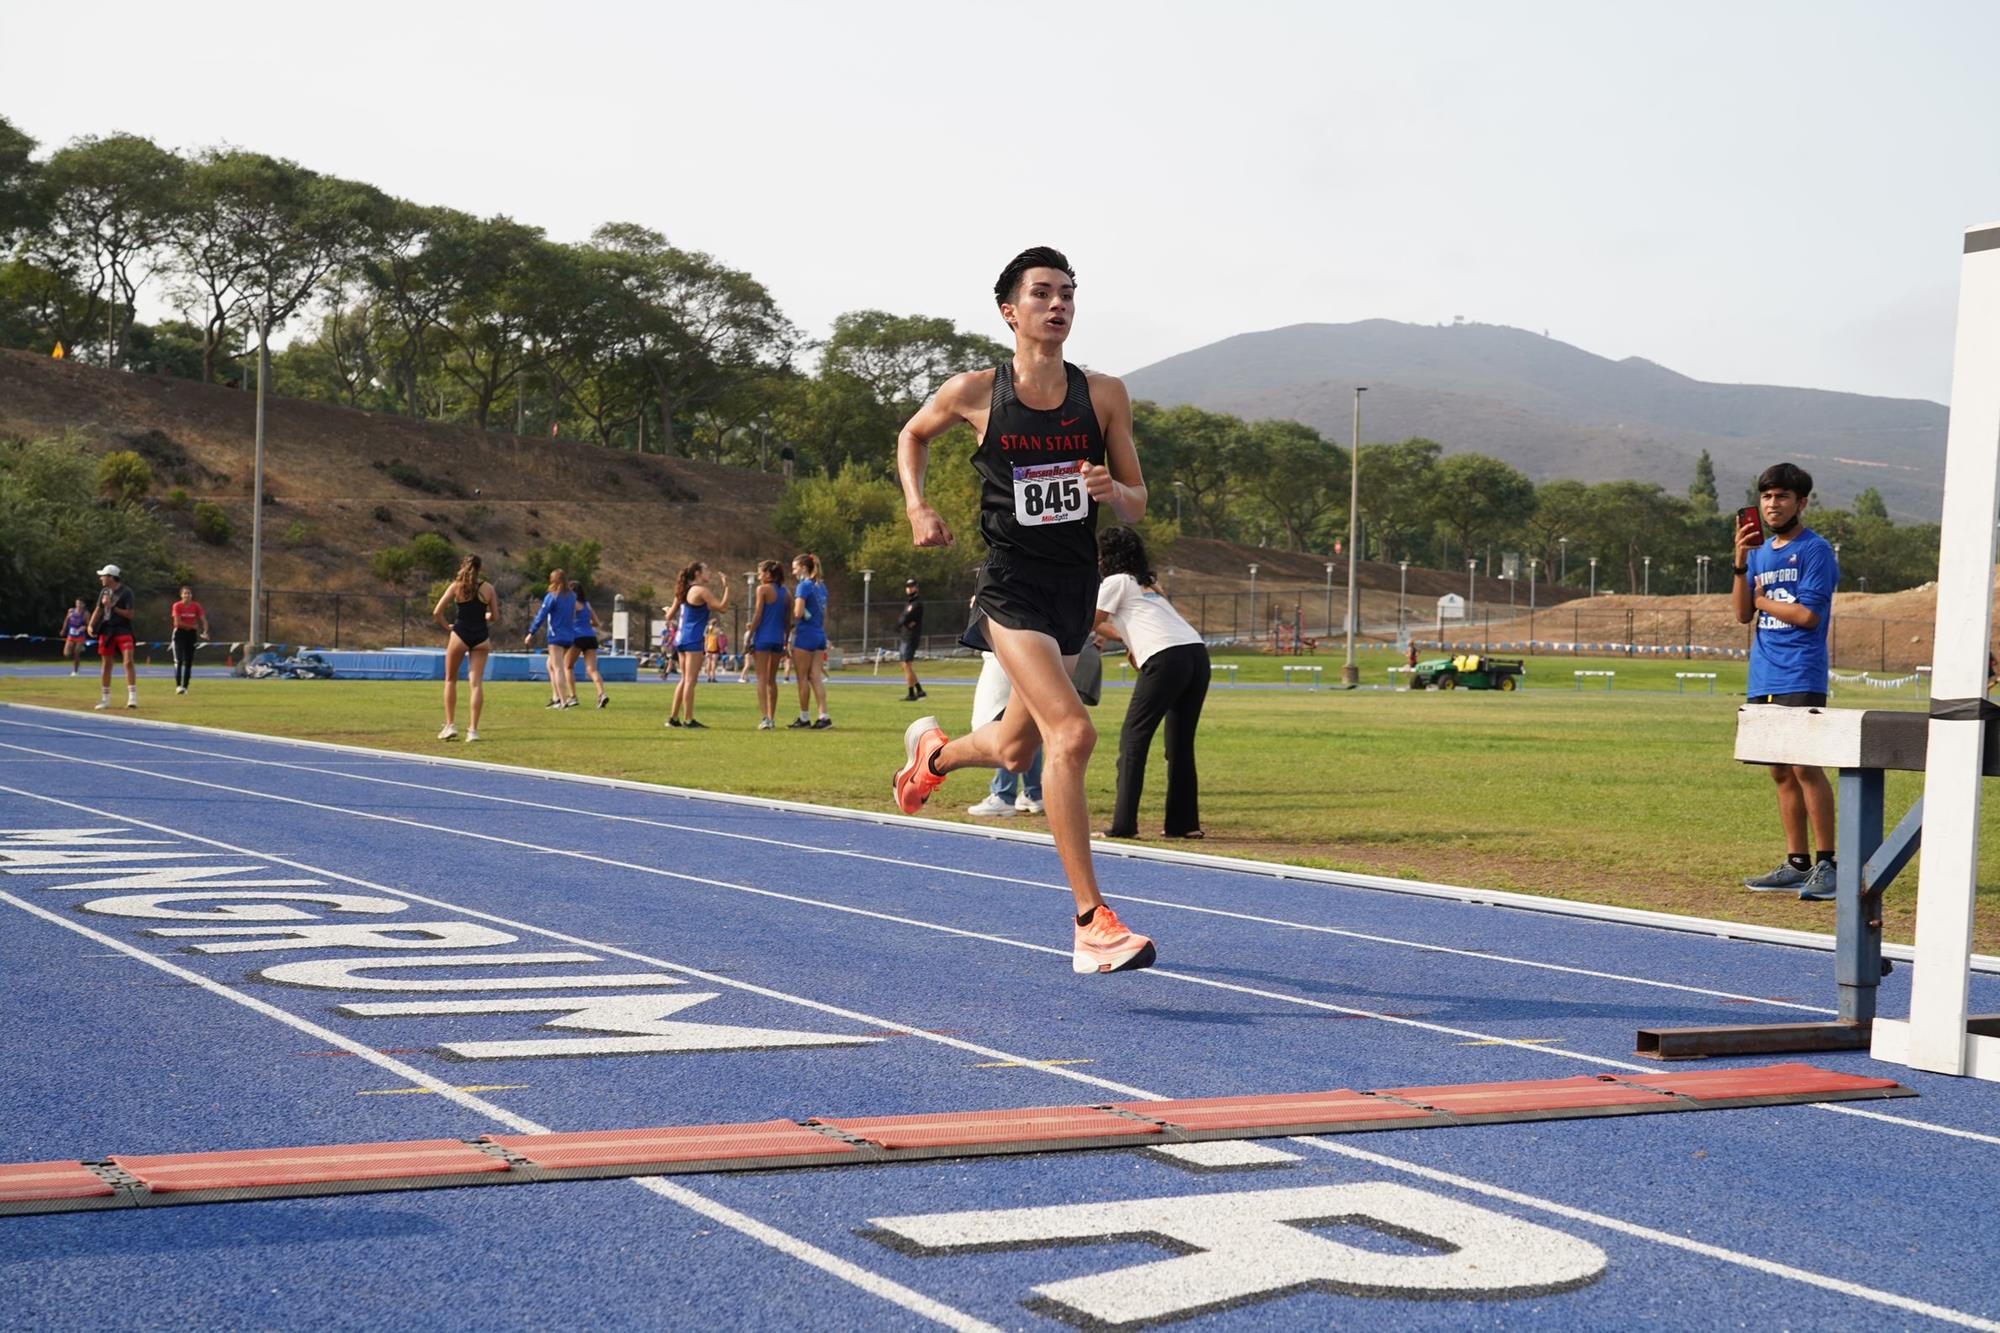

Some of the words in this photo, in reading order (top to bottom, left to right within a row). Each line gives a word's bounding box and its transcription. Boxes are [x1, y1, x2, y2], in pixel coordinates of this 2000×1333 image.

[1000, 434, 1042, 450] STAN
[1046, 434, 1089, 450] STATE
[1024, 479, 1081, 516] 845
[1041, 513, 1069, 522] MileSplit
